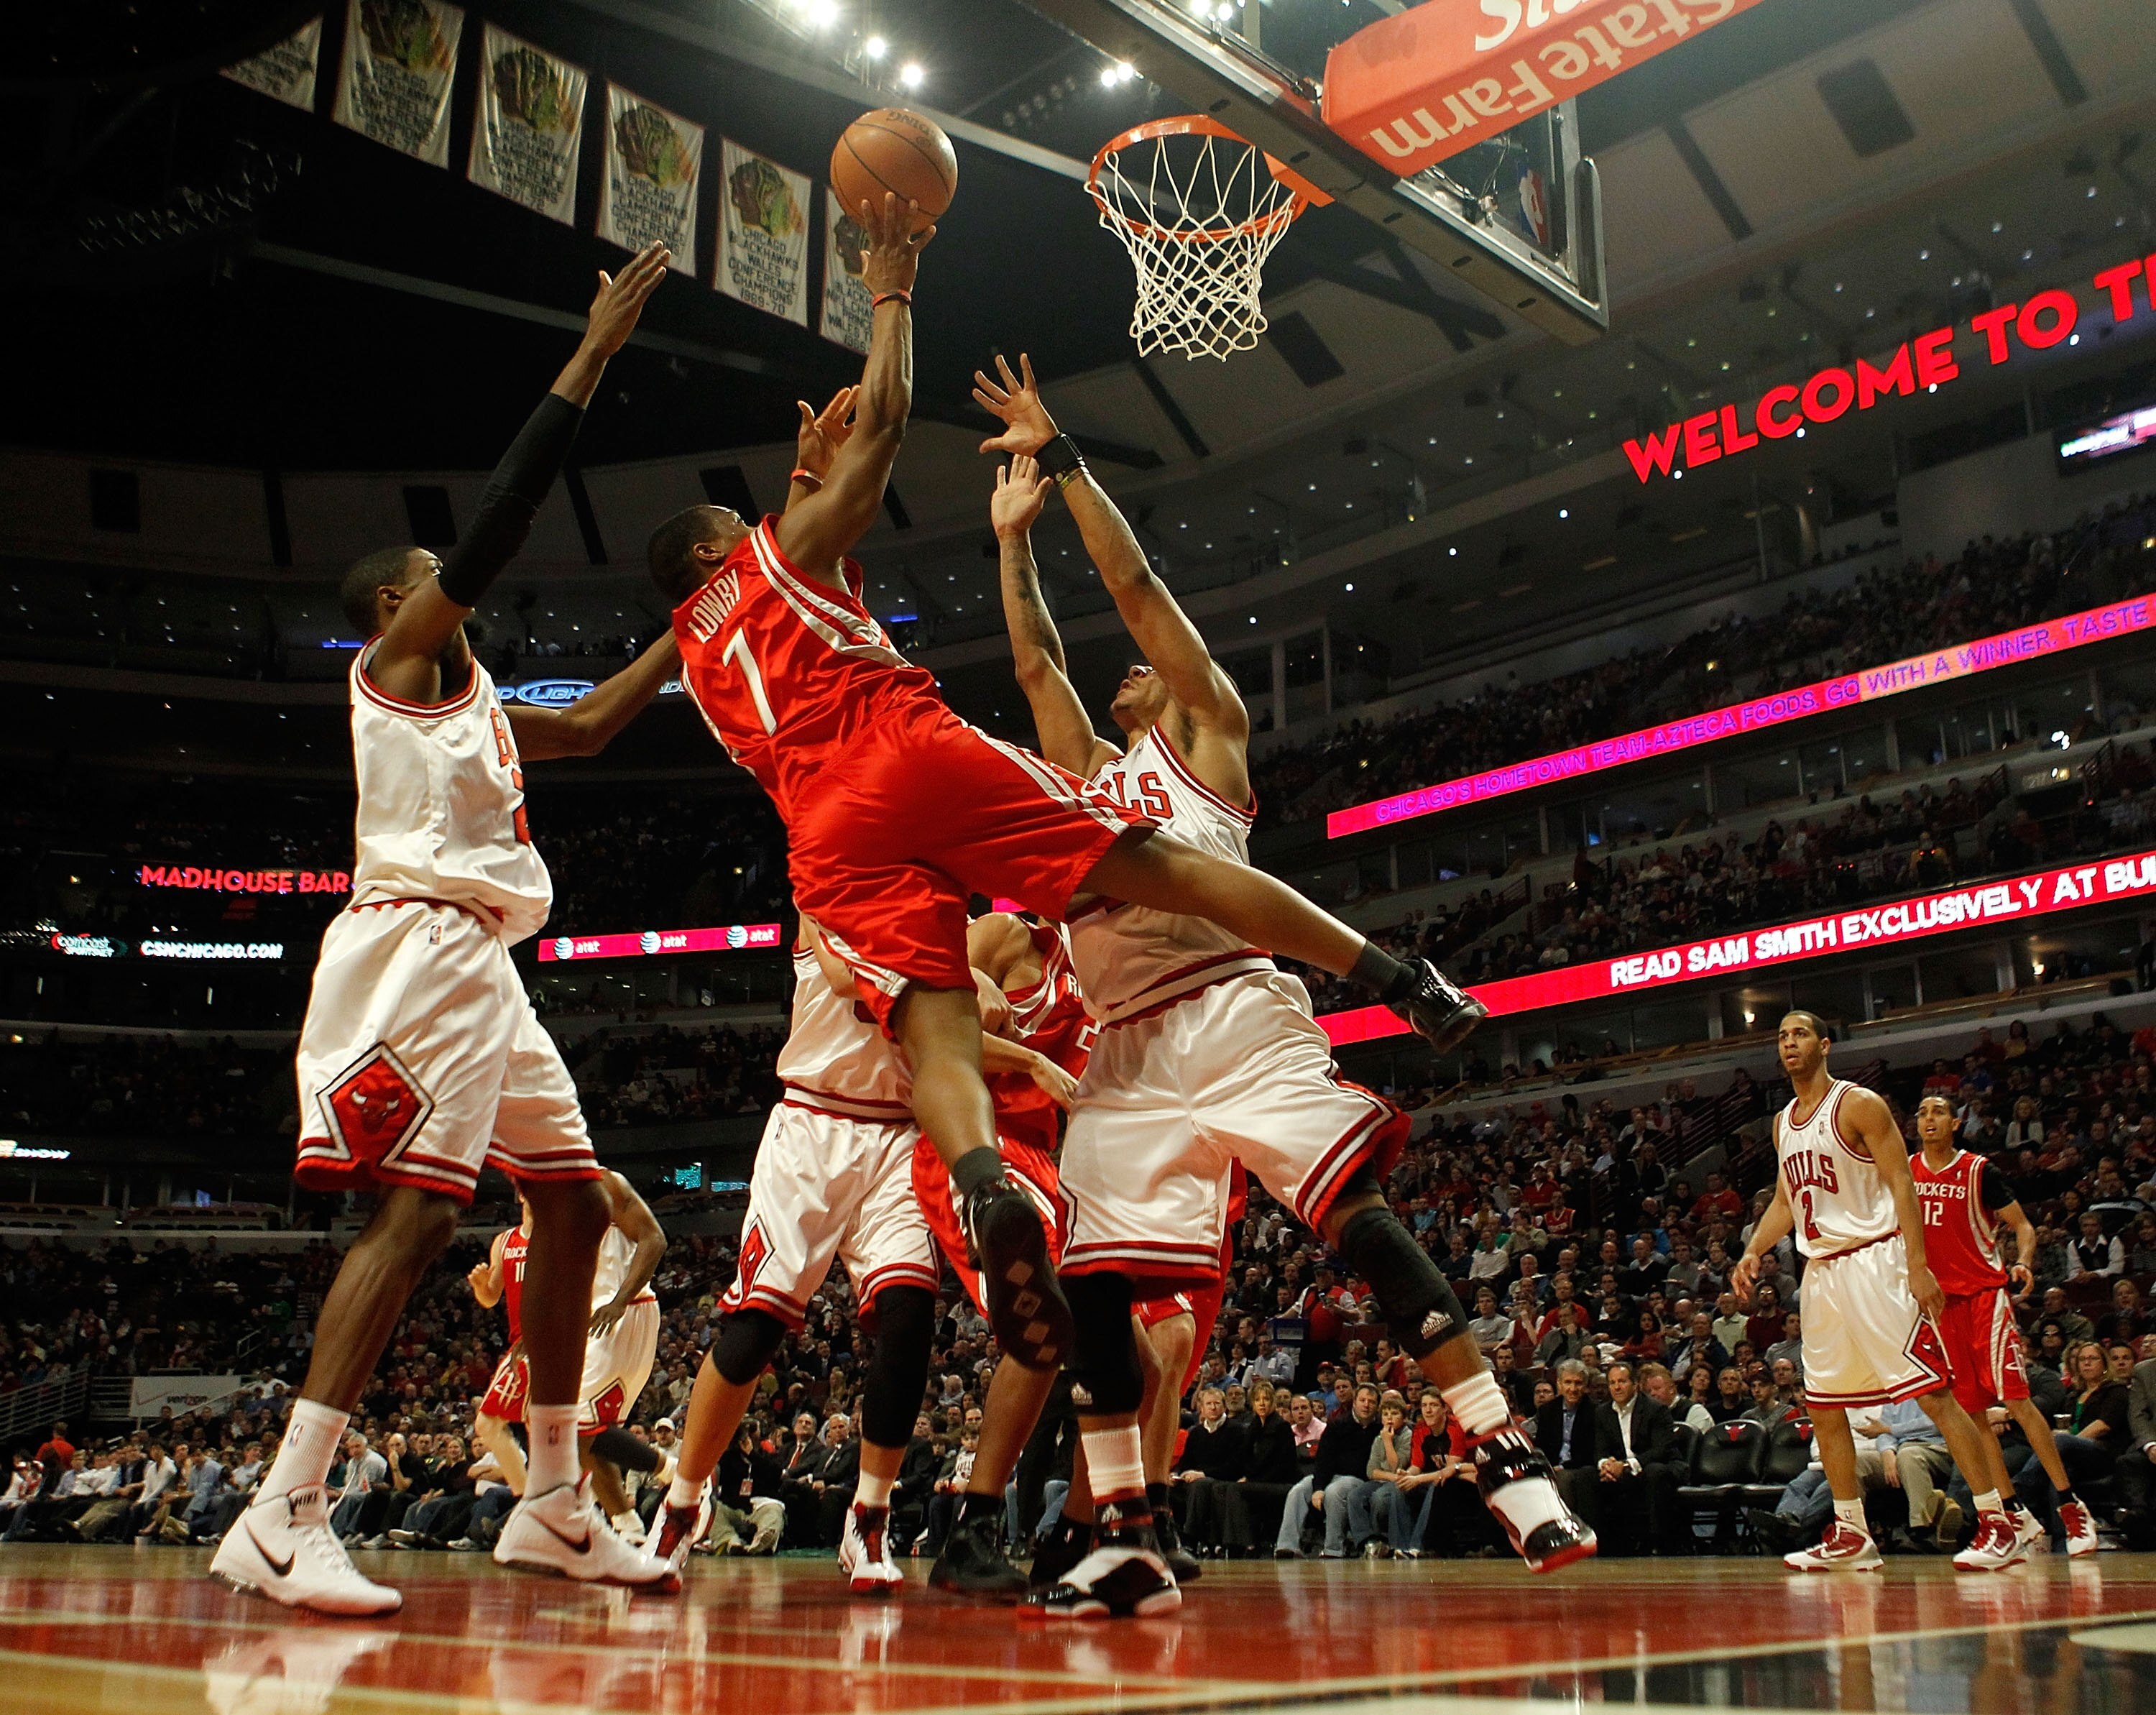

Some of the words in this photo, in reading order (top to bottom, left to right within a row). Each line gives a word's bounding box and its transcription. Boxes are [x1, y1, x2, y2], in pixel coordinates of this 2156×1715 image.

[1369, 59, 1554, 157] Farm
[742, 225, 786, 254] CHICAGO
[728, 254, 796, 295] CONFERENCE
[747, 253, 780, 277] WALES
[732, 270, 792, 307] CHAMPIONS
[740, 287, 785, 316] 1969-70
[1622, 326, 1959, 484] WELCOME
[1971, 290, 2078, 364] TO
[688, 569, 741, 644] LOWRY
[1377, 782, 1471, 819] CHICAGO'S
[1475, 751, 1586, 792] HOMETOWN
[1828, 679, 1860, 702] GO
[1866, 661, 1926, 694] WITH
[1933, 655, 1950, 677] A
[2064, 600, 2149, 640] TASTE
[142, 865, 294, 893] MADHOUSE
[299, 871, 349, 893] BAR
[1611, 950, 1682, 988] READ
[1687, 937, 1750, 973] SAM
[1754, 919, 1837, 960] SMITH
[1841, 877, 2043, 944] EXCLUSIVELY
[2053, 867, 2098, 904] AT
[140, 939, 283, 959] CSNCHICAGO.COM
[1913, 1181, 1967, 1200] OCKETS
[1801, 1190, 1823, 1241] 2
[1923, 1200, 1943, 1226] 12
[504, 1246, 528, 1260] ROCK
